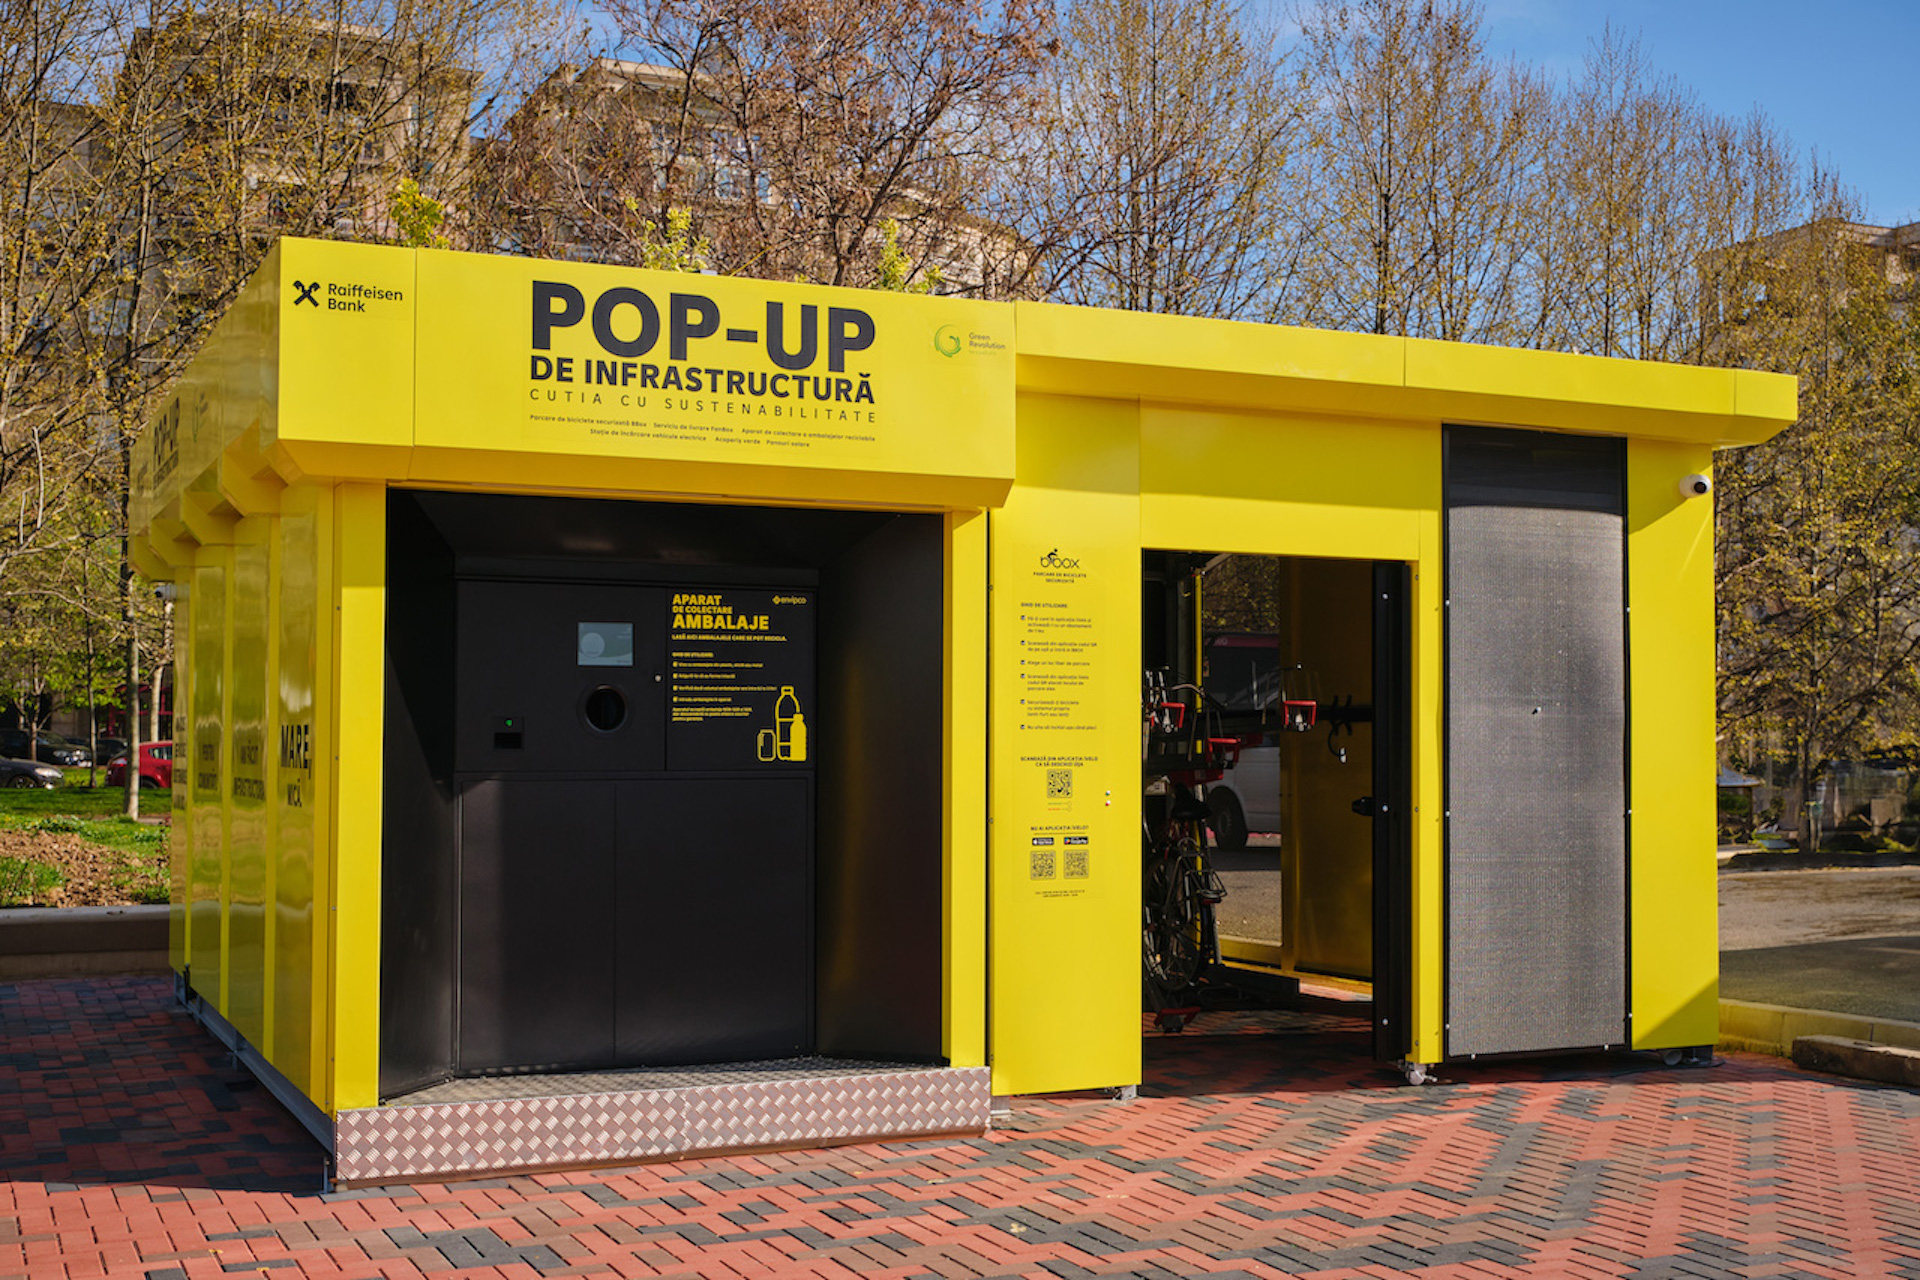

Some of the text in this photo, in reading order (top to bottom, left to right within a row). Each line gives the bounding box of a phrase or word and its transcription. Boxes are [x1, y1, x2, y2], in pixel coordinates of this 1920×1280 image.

[328, 283, 403, 301] Raiffeisen
[328, 298, 366, 313] Bank
[532, 280, 876, 373] POP-UP
[530, 355, 876, 404] DE INFRASTRUCTURĂ
[530, 388, 876, 424] CUTIA CU SUSTENABILITATE
[530, 414, 556, 422] Parcare
[672, 593, 722, 605] APARAT
[672, 605, 733, 614] DE COLECTARE
[672, 614, 770, 630] AMBALAJE
